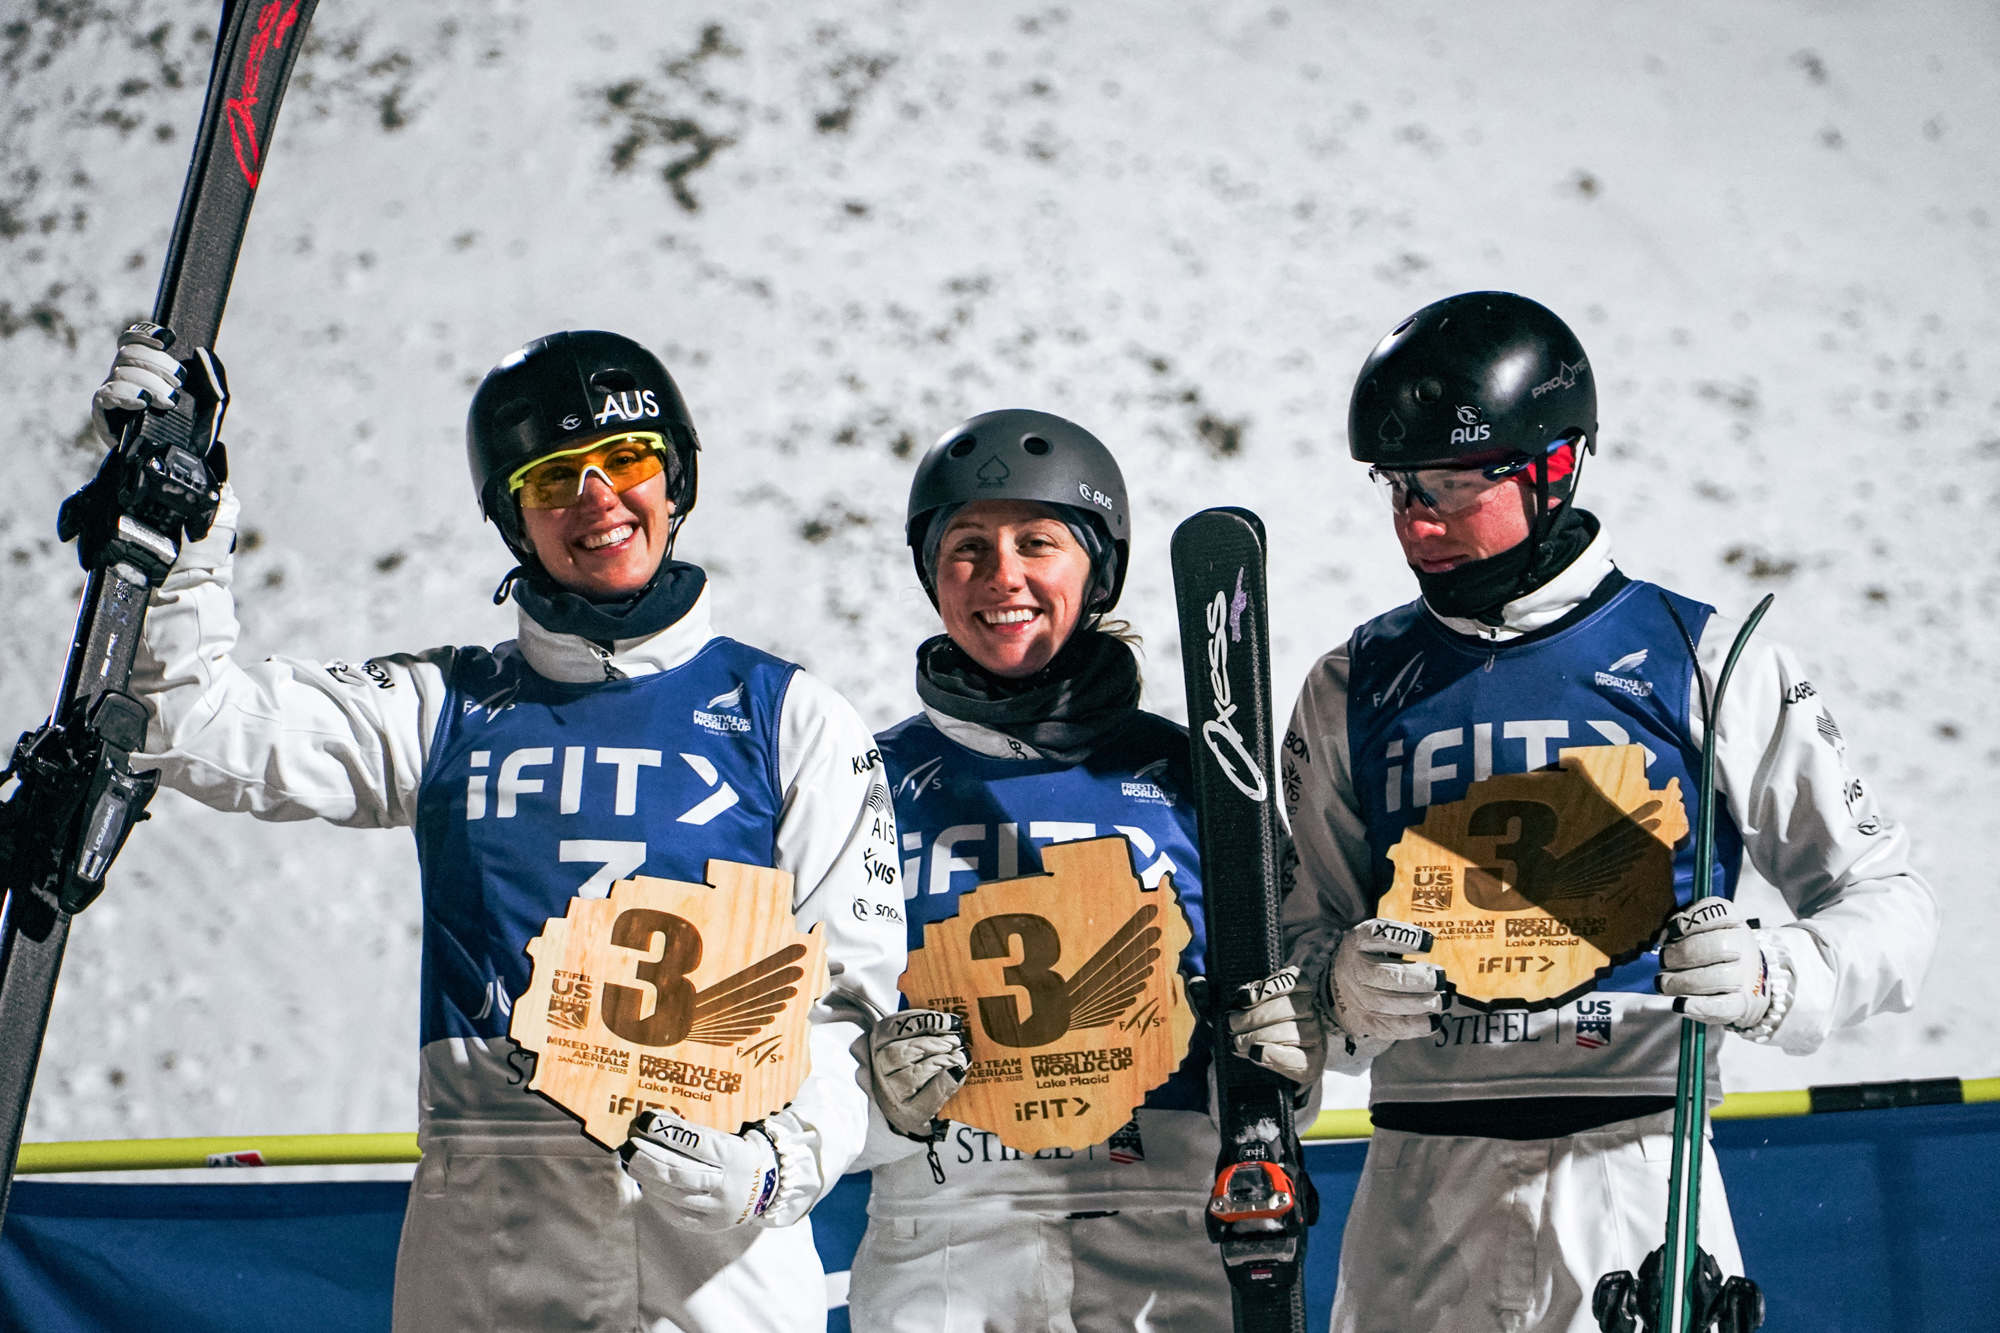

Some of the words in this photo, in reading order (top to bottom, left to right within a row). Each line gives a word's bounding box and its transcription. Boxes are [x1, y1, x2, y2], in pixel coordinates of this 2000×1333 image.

[594, 389, 660, 425] AUS
[1450, 424, 1491, 445] AUS
[1092, 490, 1113, 511] AUS
[1595, 678, 1631, 692] WORLD
[693, 709, 738, 723] FREESTYLE
[738, 718, 752, 726] SKI
[693, 718, 729, 731] WORLD
[730, 723, 752, 733] CUP
[1386, 719, 1570, 813] iFIT
[466, 746, 663, 820] iFIT
[1122, 789, 1160, 798] WORLD
[871, 817, 896, 845] AIS
[1463, 798, 1560, 912] 3
[873, 860, 896, 885] VIS
[1414, 865, 1454, 873] STIFEL
[1414, 872, 1454, 887] US
[1459, 919, 1495, 927] TEAM
[1505, 917, 1584, 928] FREESTYLE
[1682, 903, 1727, 930] XTM
[1372, 923, 1417, 945] XTM
[1438, 926, 1495, 935] AERIALS
[1505, 925, 1568, 938] WORLD
[1570, 926, 1605, 936] CUP
[1505, 938, 1536, 947] Lake
[1539, 937, 1580, 947] Placid
[1478, 956, 1534, 974] iFIT
[554, 969, 593, 984] STIFEL
[602, 907, 704, 1048] 3
[970, 912, 1072, 1048] 3
[551, 978, 593, 1000] US
[928, 996, 967, 1006] STIFEL
[1575, 1000, 1612, 1015] US
[896, 1012, 944, 1035] XTM
[1435, 1012, 1541, 1048] STIFEL
[547, 1036, 589, 1051] MIXED
[593, 1044, 630, 1060] TEAM
[1030, 1049, 1107, 1065] FREESTYLE
[1109, 1047, 1132, 1059] SKI
[557, 1055, 595, 1069] JANUARY
[608, 1067, 628, 1075] 2025
[572, 1050, 629, 1068] AERIALS
[984, 1057, 1022, 1069] TEAM
[1031, 1060, 1096, 1078] WORLD
[1097, 1058, 1134, 1072] CUP
[639, 1054, 717, 1078] FREESTYLE
[719, 1070, 743, 1085] SKI
[639, 1064, 701, 1088] WORLD
[703, 1079, 741, 1095] CUP
[968, 1066, 1023, 1079] AERIALS
[638, 1079, 669, 1093] Lake
[671, 1086, 712, 1102] Placid
[1036, 1078, 1067, 1089] Lake
[1069, 1074, 1110, 1087] Placid
[1014, 1098, 1068, 1122] iFIT
[654, 1119, 700, 1149] XTM
